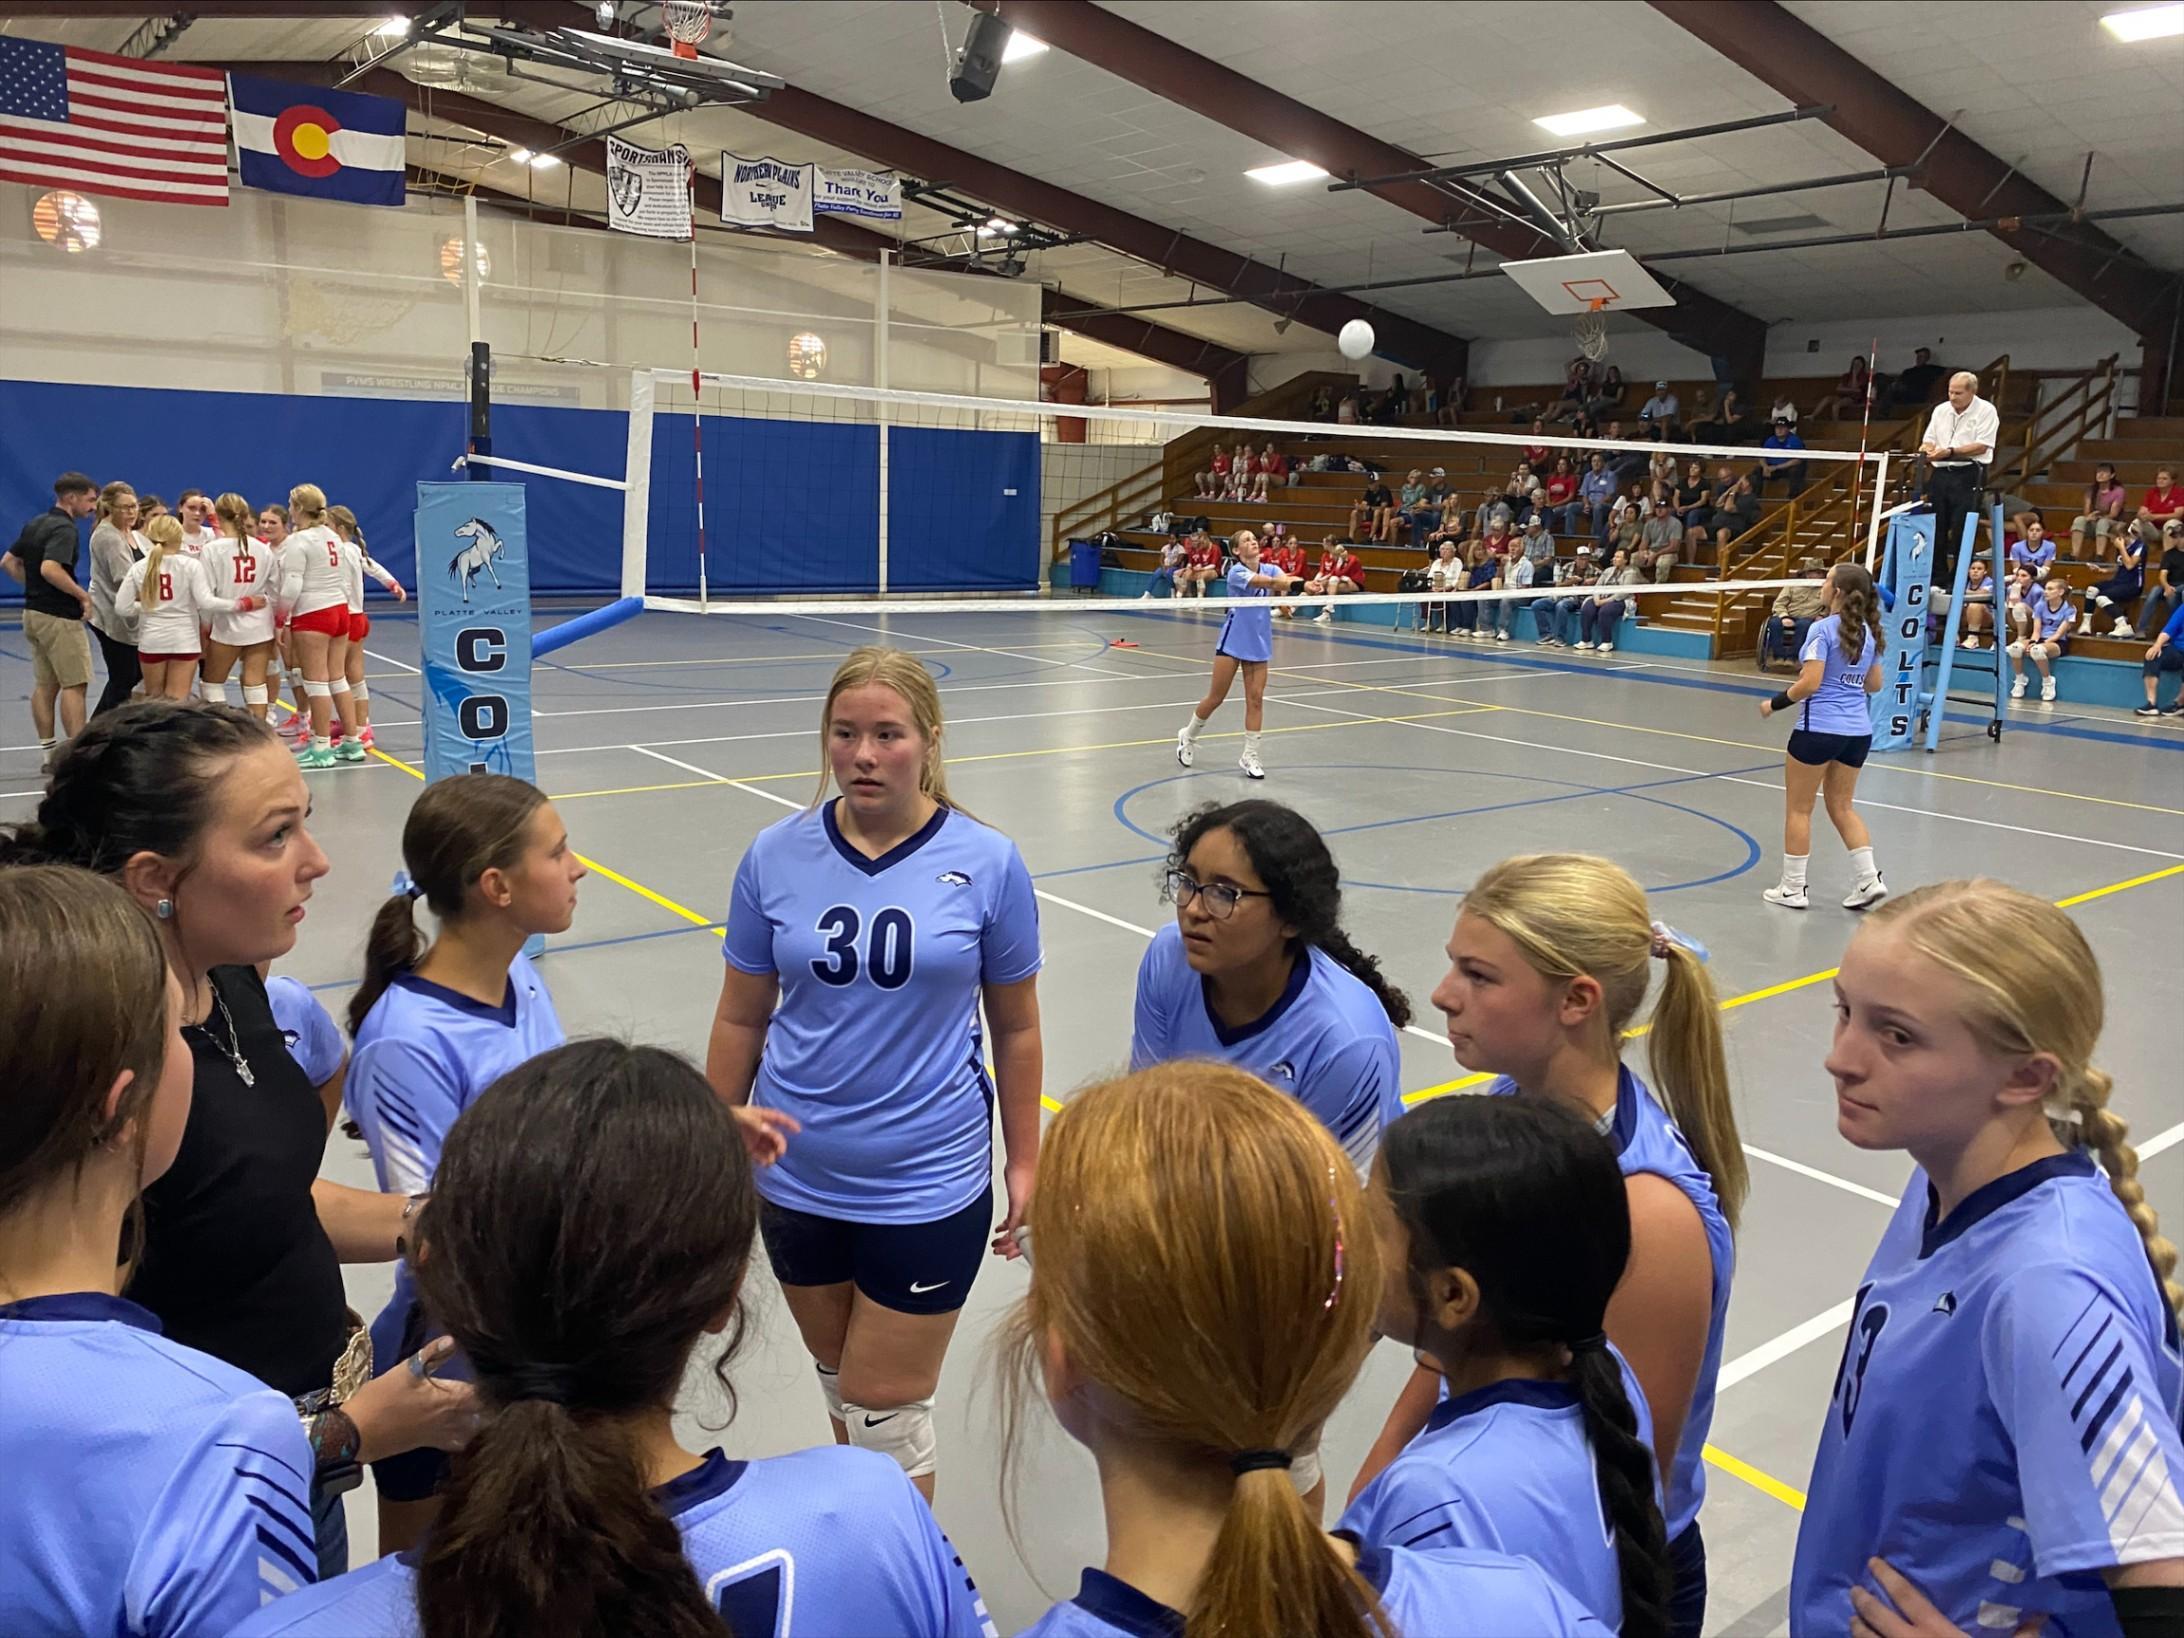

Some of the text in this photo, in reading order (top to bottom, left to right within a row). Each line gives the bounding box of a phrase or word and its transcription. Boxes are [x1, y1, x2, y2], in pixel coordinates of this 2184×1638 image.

[773, 164, 800, 190] PLAINS
[866, 188, 889, 203] You
[345, 375, 375, 386] PVMS
[376, 377, 432, 389] WRESTLING
[326, 541, 339, 567] 5
[232, 555, 257, 583] 12
[159, 573, 174, 601] 8
[1890, 583, 1924, 737] COLTS
[1839, 672, 1865, 687] COLTS
[808, 903, 916, 991] 30
